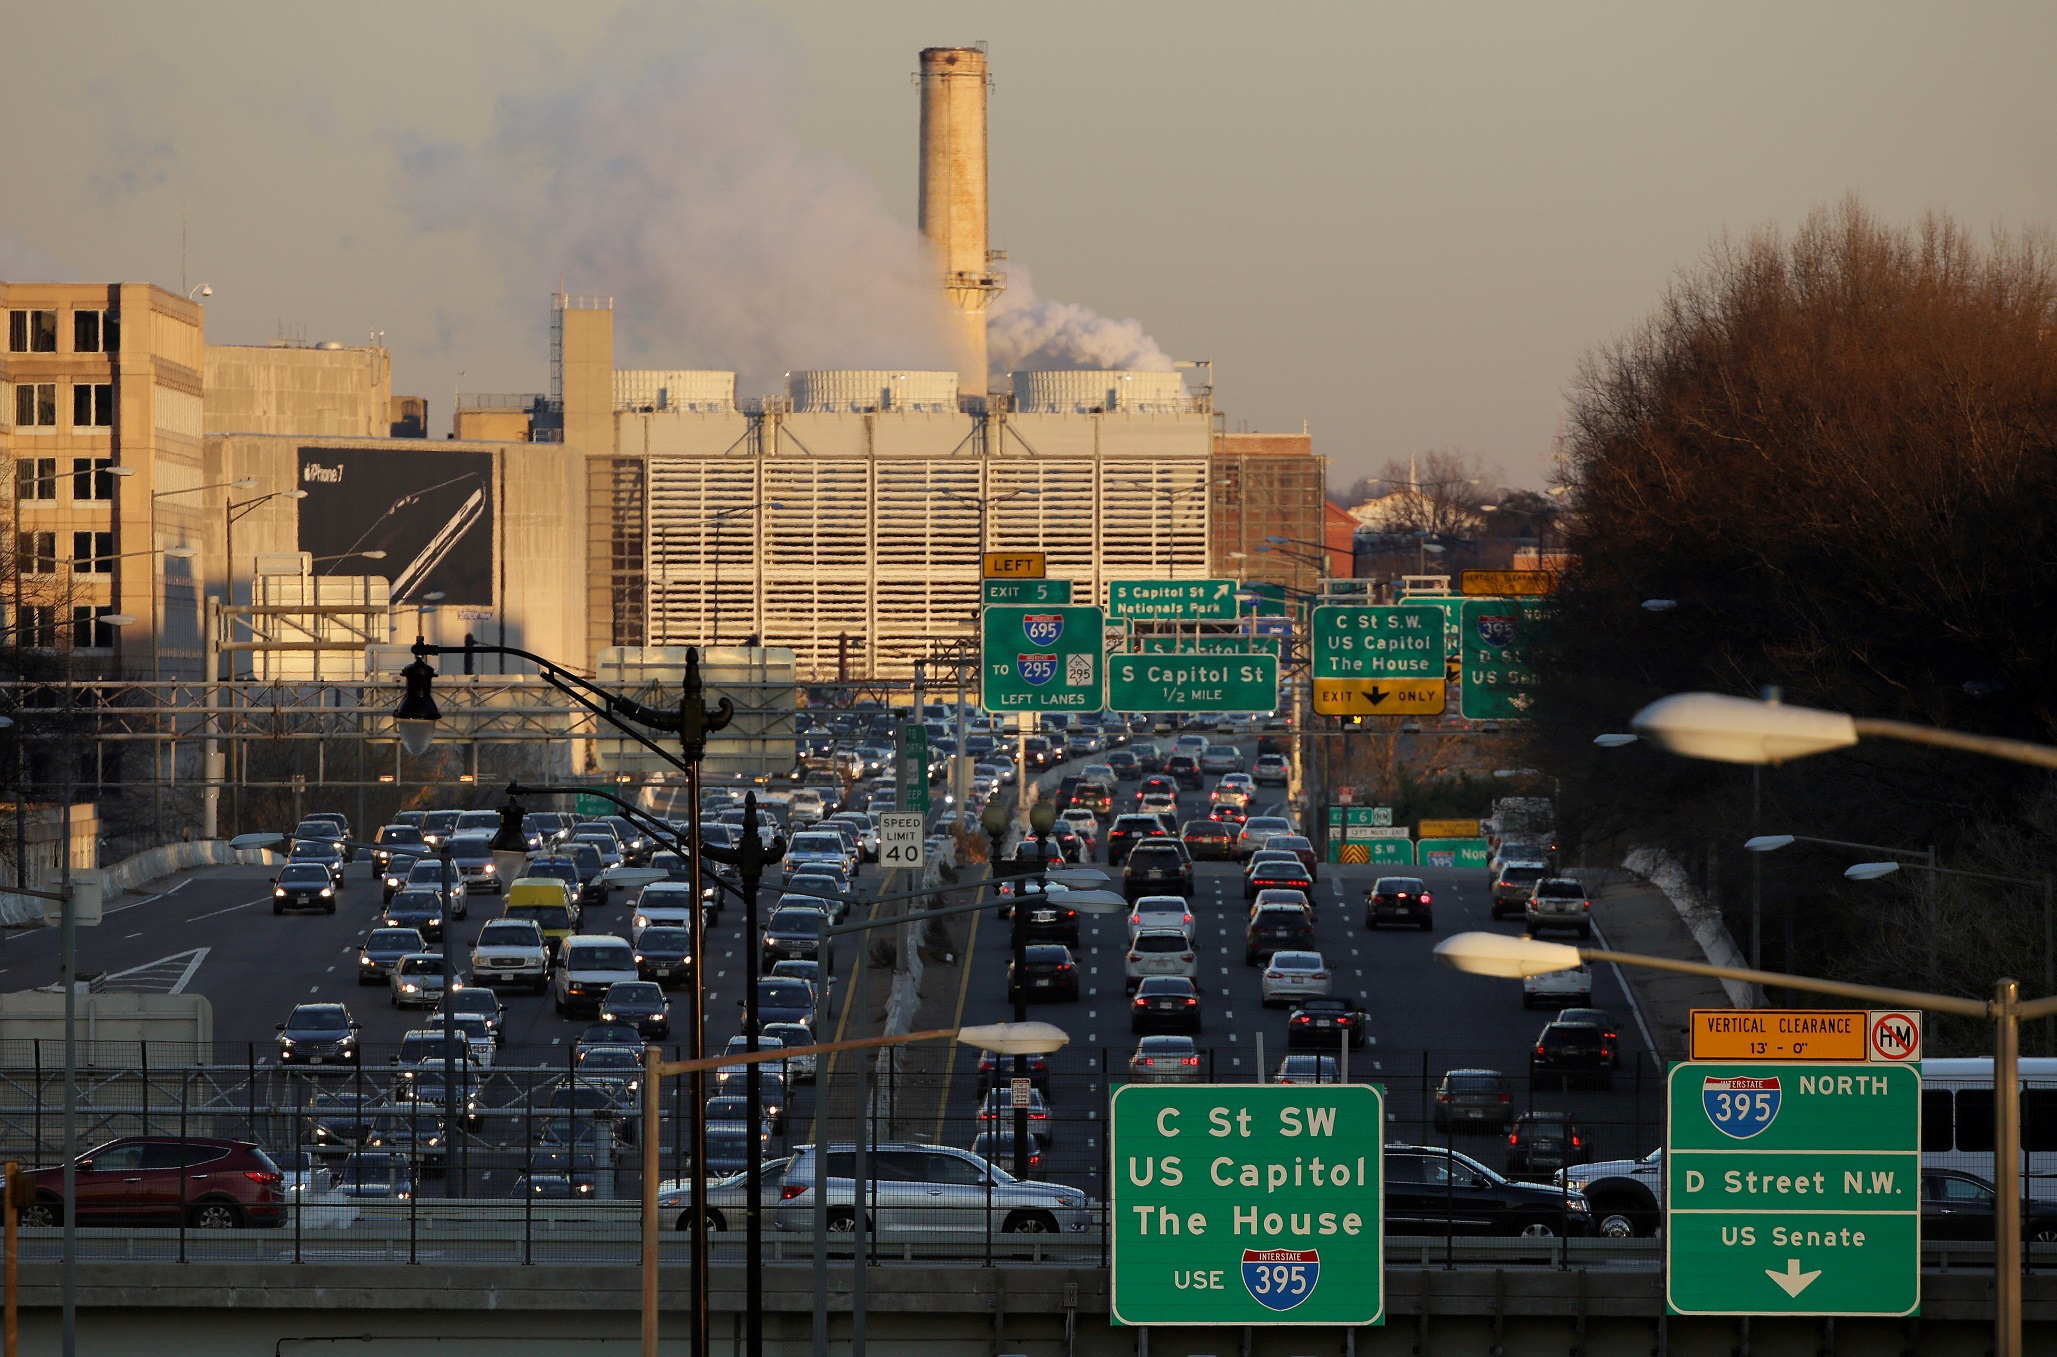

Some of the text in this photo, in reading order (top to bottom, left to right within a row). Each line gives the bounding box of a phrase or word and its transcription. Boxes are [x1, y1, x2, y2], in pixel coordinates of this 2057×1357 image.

[337, 464, 344, 482] 7
[994, 559, 1033, 571] LEFT
[990, 584, 1048, 599] EXIT 5
[1117, 586, 1205, 600] S Capitol St
[1117, 602, 1221, 614] Nationals Park
[1336, 615, 1422, 629] C St S.W.
[1030, 622, 1057, 638] 695
[1328, 636, 1353, 650] US
[1364, 635, 1430, 652] Capitol
[993, 662, 1051, 677] TO 295
[1329, 657, 1429, 671] The House
[1069, 668, 1091, 680] 295
[1122, 666, 1264, 686] S Capitol St
[1472, 670, 1498, 684] US
[1001, 694, 1086, 705] LEFT LANES
[1191, 689, 1223, 701] MILE
[1322, 691, 1436, 701] EXIT ONLY
[906, 743, 924, 753] ORTH
[907, 789, 922, 800] EEP
[883, 818, 921, 828] SPEED
[1359, 811, 1368, 822] 6
[886, 832, 916, 841] LIMIT
[886, 845, 919, 862] 40
[1707, 1018, 1851, 1034] VERTICAL CLEARANCE
[1879, 1025, 1911, 1048] HM
[1800, 1075, 1888, 1095] NORTH
[1716, 1093, 1771, 1122] 395
[1156, 1106, 1337, 1138] C St SW
[1129, 1156, 1365, 1194] US Capitol
[1686, 1170, 1902, 1194] D Street N.W.
[1132, 1205, 1363, 1236] The House
[1721, 1226, 1866, 1247] US Senate
[1259, 1252, 1302, 1262] INTERSTATE
[1174, 1265, 1307, 1295] USE 395
